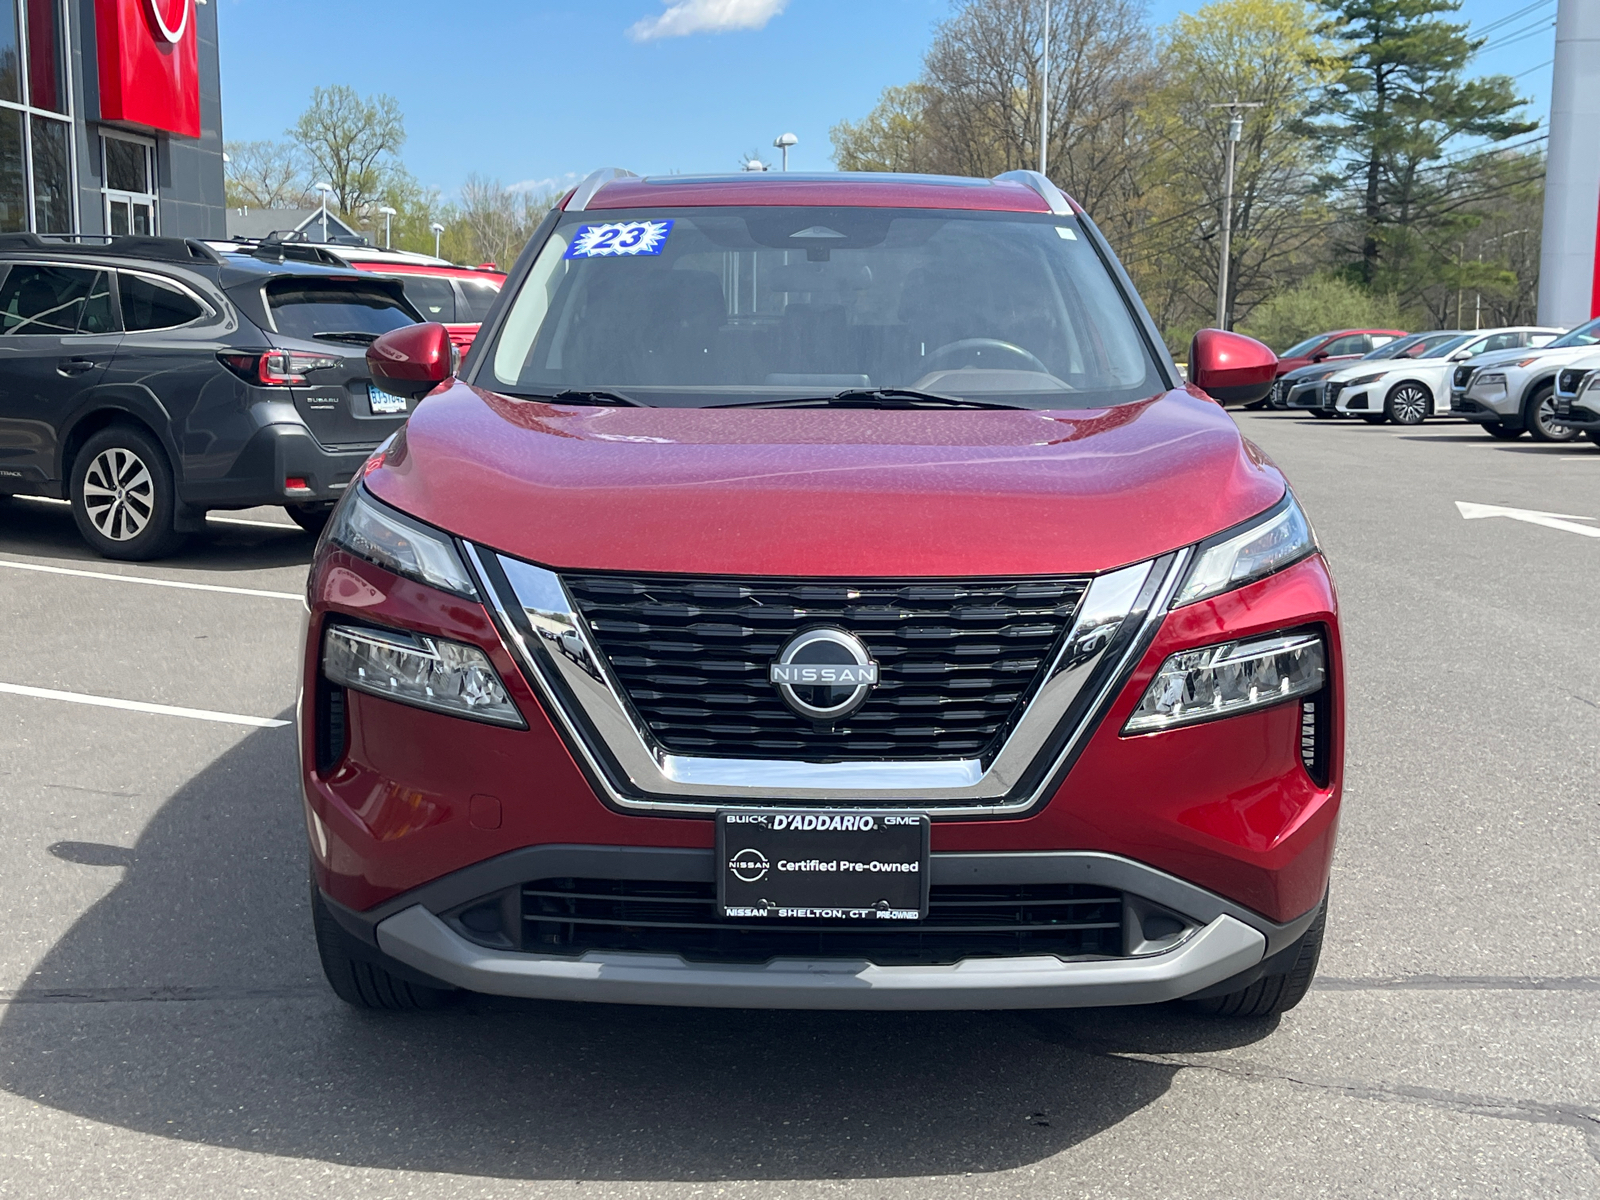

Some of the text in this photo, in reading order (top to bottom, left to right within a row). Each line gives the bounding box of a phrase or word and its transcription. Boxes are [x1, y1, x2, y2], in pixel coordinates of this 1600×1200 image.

[590, 227, 646, 250] 23
[773, 667, 875, 682] NISSAN
[726, 815, 920, 831] BUICK D'ADDARIO GMC
[728, 861, 770, 869] NISSAN
[777, 860, 919, 873] Certified Pre-Owned
[726, 908, 919, 920] NISSAN SHELTON, CT PRE-OWNED
